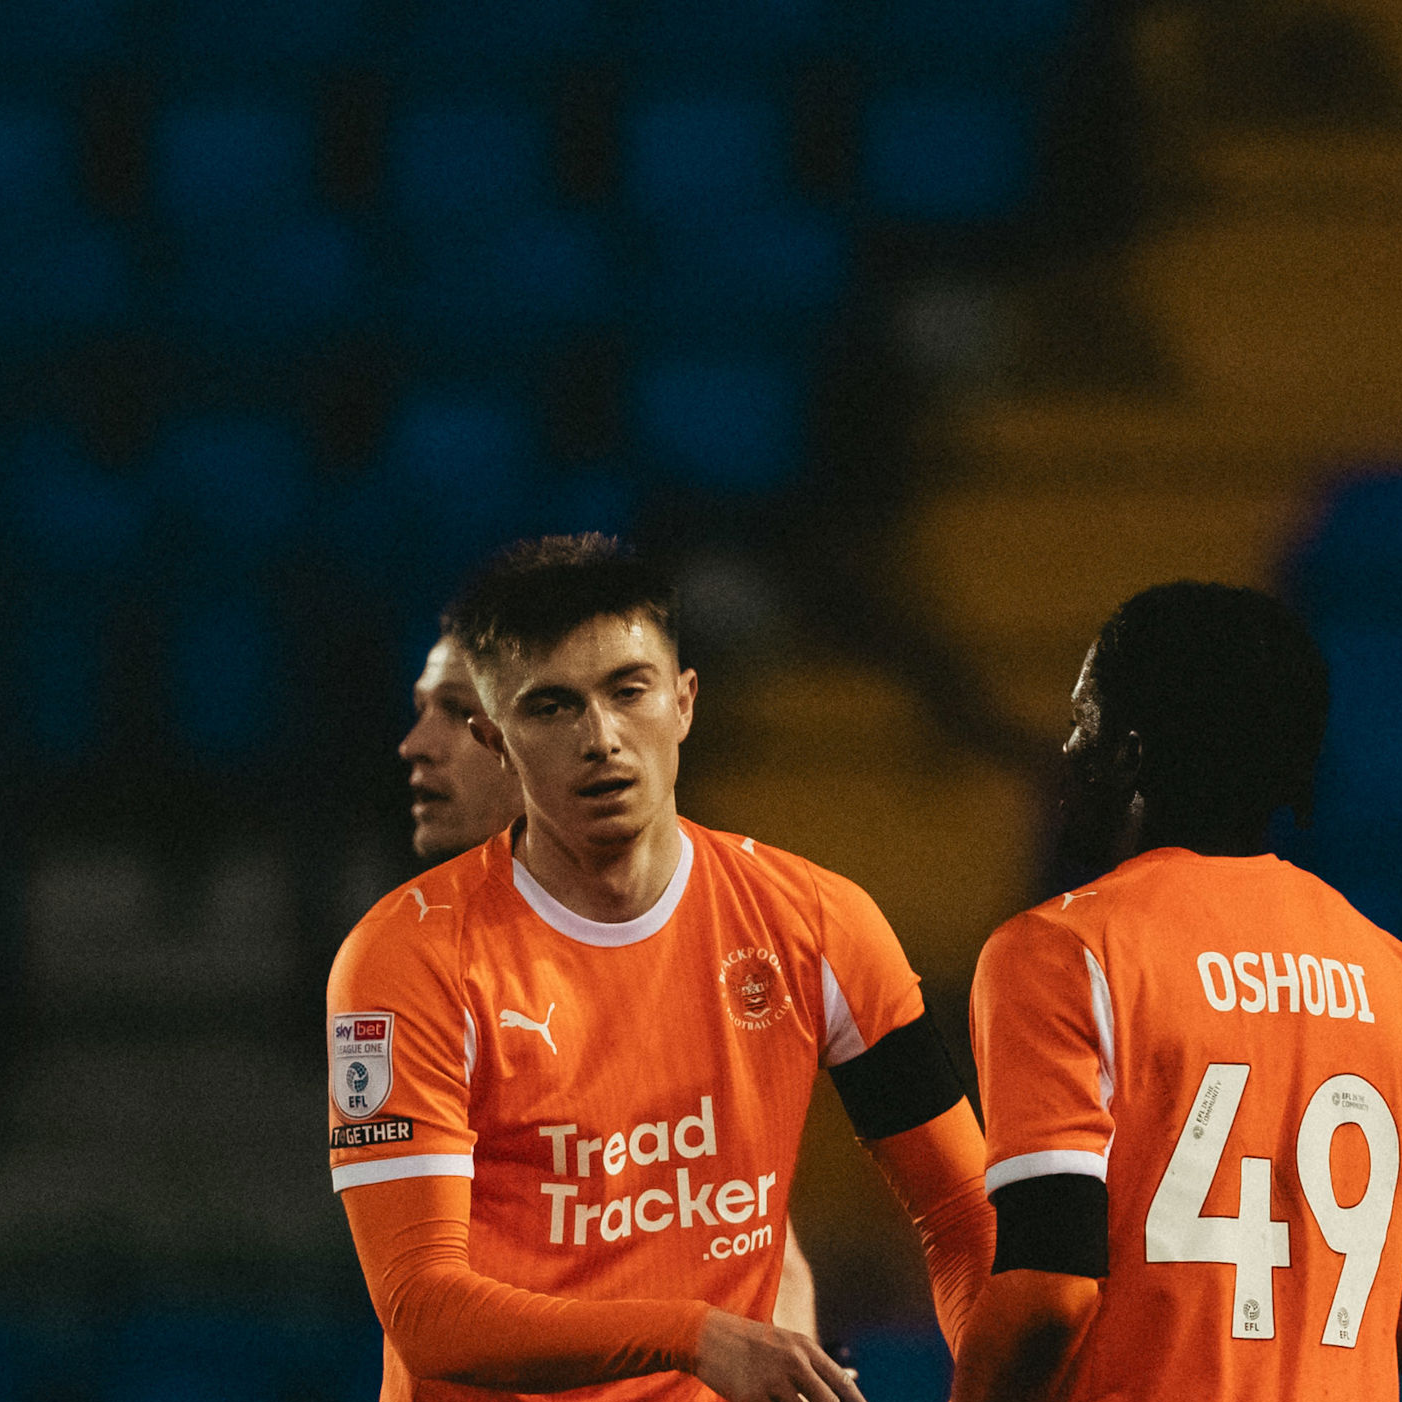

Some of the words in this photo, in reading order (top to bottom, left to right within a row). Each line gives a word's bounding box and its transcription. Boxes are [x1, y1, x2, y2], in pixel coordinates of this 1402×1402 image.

[1196, 951, 1376, 1024] OSHODI
[335, 1023, 353, 1041] sky
[356, 1021, 383, 1036] bet
[337, 1043, 362, 1055] LEAGUE
[364, 1042, 383, 1054] ONE
[348, 1095, 368, 1108] EFL
[538, 1095, 717, 1178] Tread
[540, 1167, 776, 1246] Tracker
[1145, 1062, 1401, 1349] 49
[703, 1224, 773, 1260] .com
[1244, 1322, 1260, 1332] EFL
